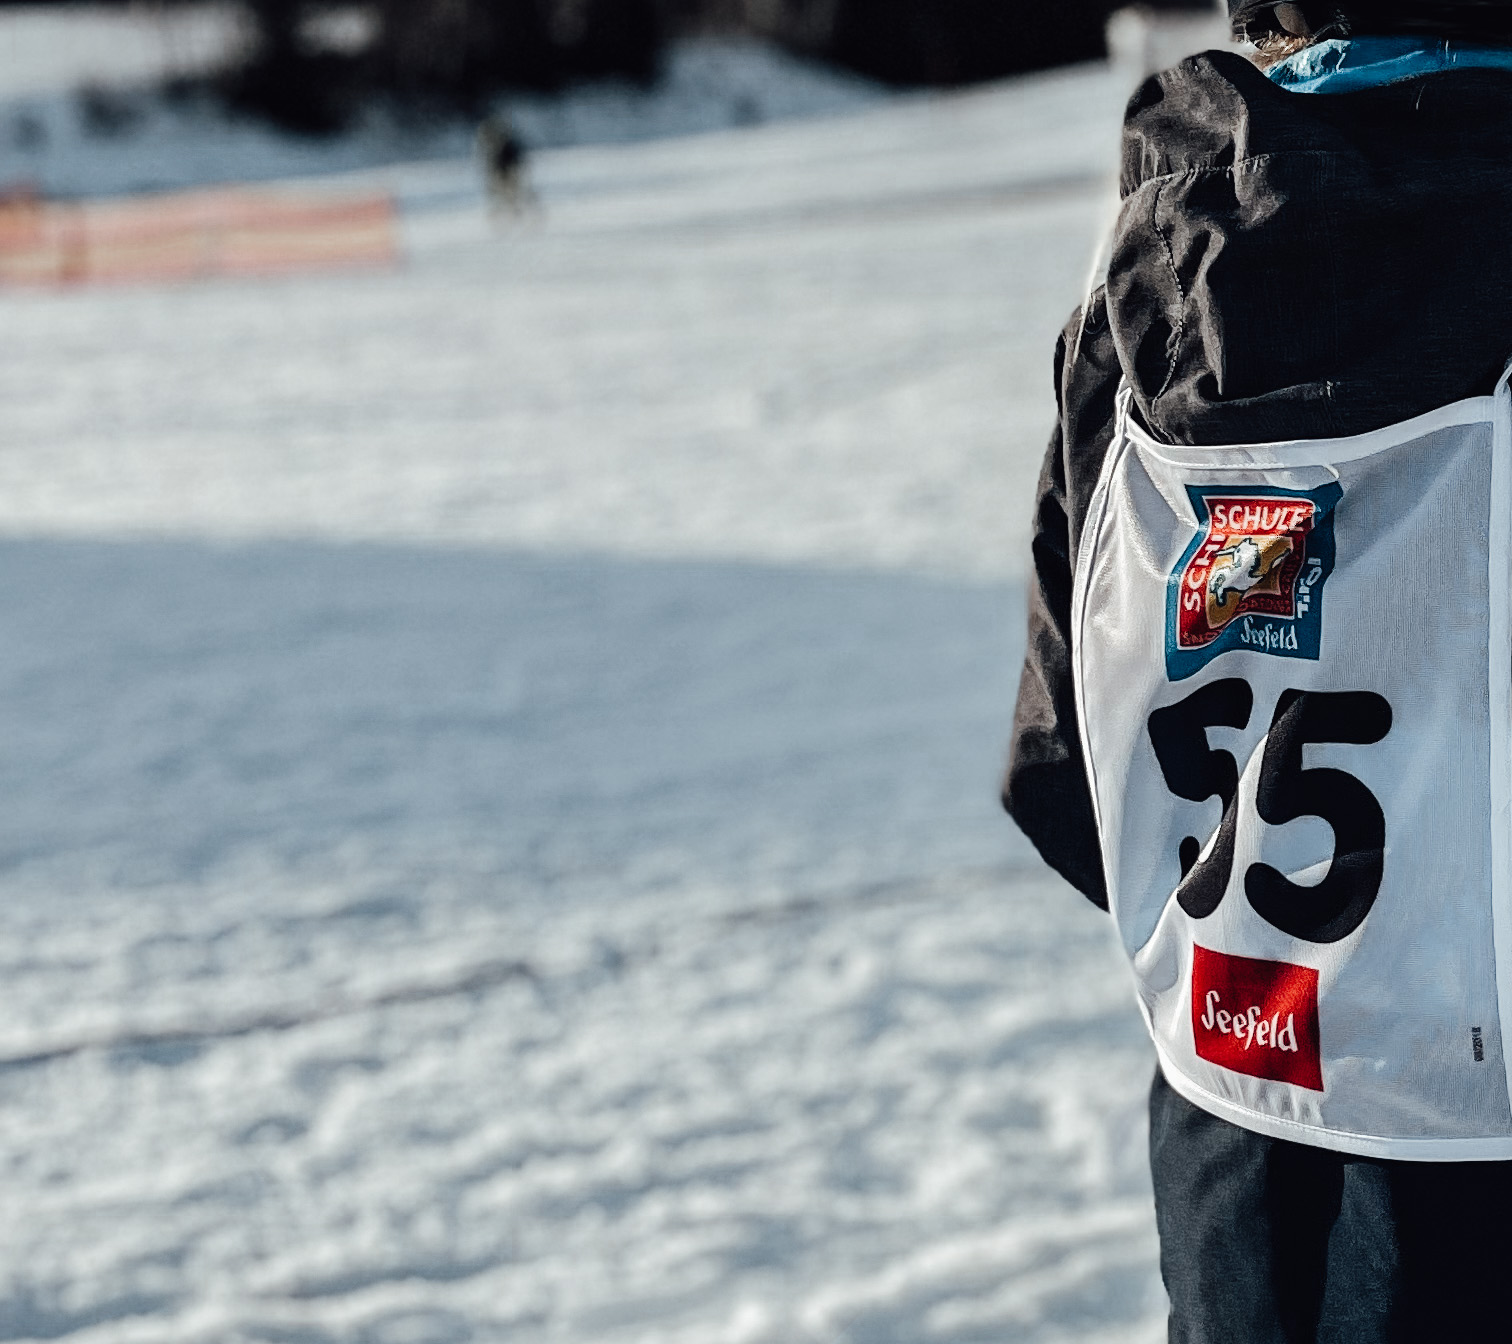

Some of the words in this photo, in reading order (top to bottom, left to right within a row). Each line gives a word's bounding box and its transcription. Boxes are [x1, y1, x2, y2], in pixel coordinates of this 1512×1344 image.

[1213, 504, 1305, 532] SCHULE
[1240, 614, 1299, 651] Seefeld
[1147, 676, 1394, 944] 55
[1200, 989, 1299, 1053] Seefeld
